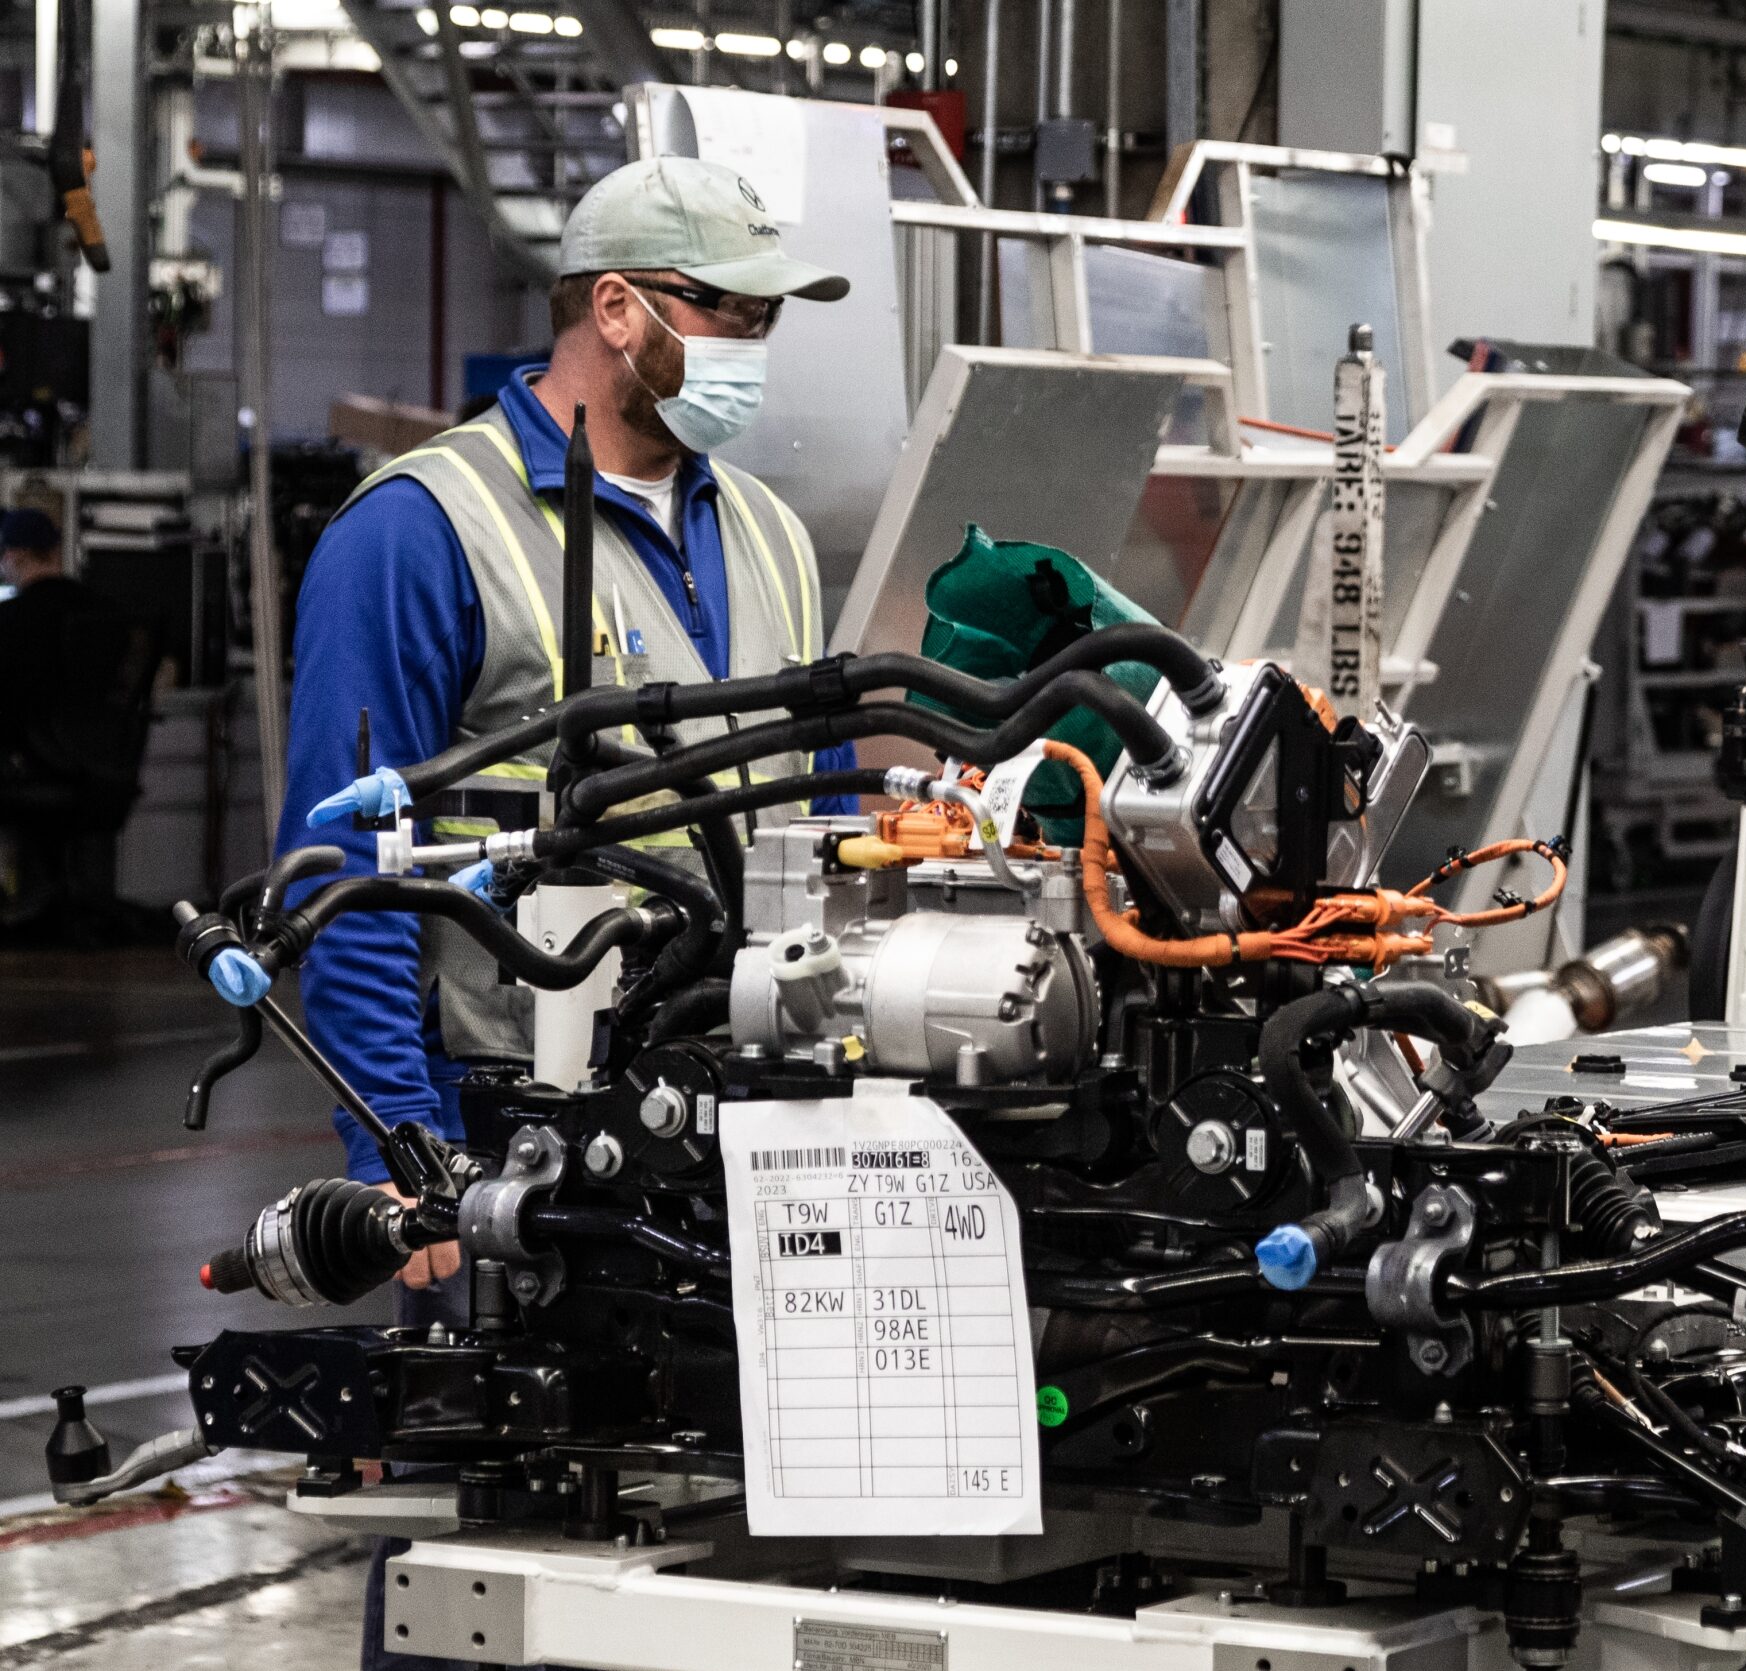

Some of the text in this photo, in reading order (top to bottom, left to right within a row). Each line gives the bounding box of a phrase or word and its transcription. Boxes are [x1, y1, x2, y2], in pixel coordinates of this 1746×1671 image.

[1332, 532, 1362, 604] 948
[1330, 624, 1361, 696] LBS
[852, 1151, 930, 1168] 3070161=8
[756, 1184, 787, 1196] 2023
[847, 1172, 998, 1194] ZY T9W G1Z USA
[782, 1202, 829, 1224] T9W
[874, 1201, 913, 1225] G1Z
[944, 1204, 986, 1240] 4WD
[781, 1232, 825, 1256] ID4
[784, 1291, 845, 1313] 82KW
[872, 1290, 927, 1311] 31DL
[873, 1319, 929, 1341] 98AE
[962, 1469, 1009, 1492] 145 E
